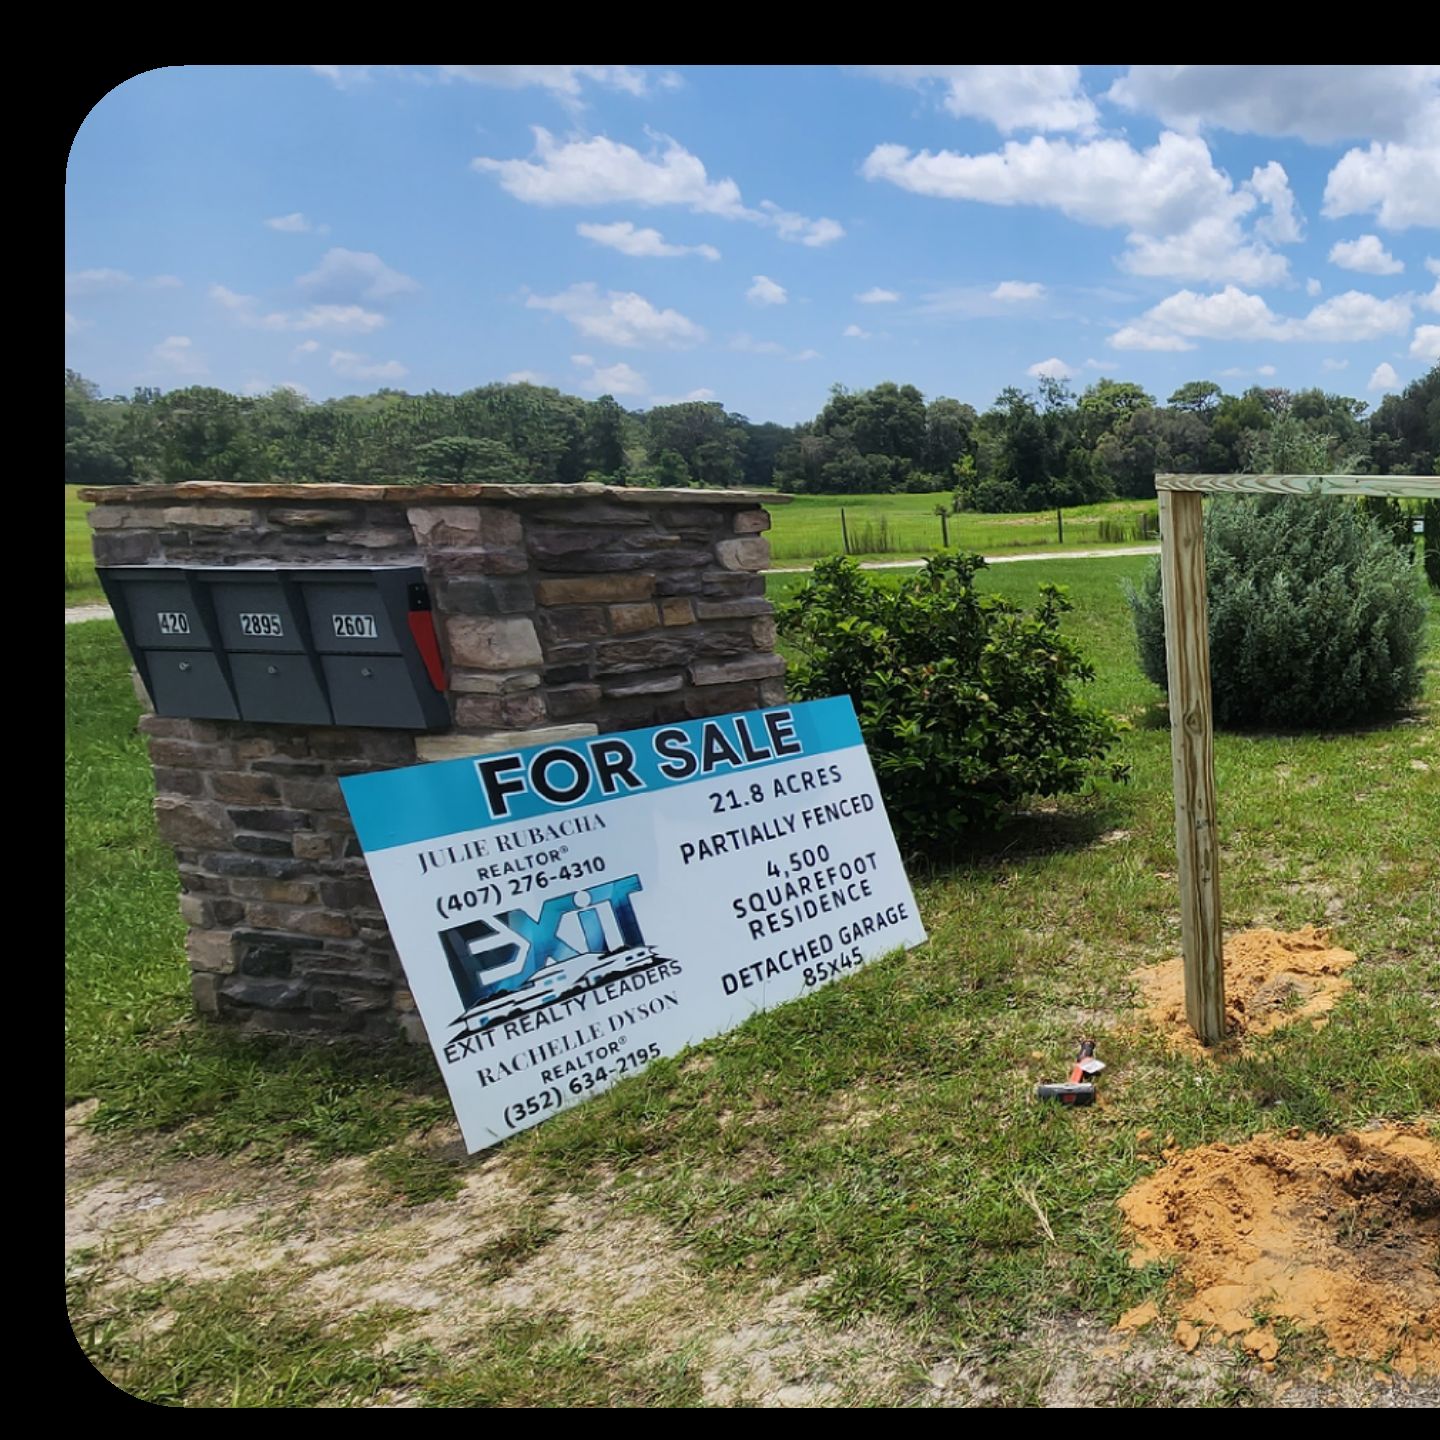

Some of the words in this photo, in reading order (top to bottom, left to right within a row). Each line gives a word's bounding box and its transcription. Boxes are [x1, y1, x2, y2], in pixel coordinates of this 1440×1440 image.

[160, 613, 189, 634] 420
[243, 614, 282, 636] 2895
[335, 616, 374, 637] 2607
[475, 739, 646, 819] FOR
[653, 709, 802, 781] SALE
[708, 783, 764, 813] 21.8
[773, 765, 842, 798] ACRES
[418, 839, 489, 874] JULIE
[496, 813, 606, 852] RUBACHA
[679, 814, 795, 864] PARTIALLY
[802, 793, 874, 829] FENCED
[436, 884, 502, 918] (407)
[509, 856, 606, 896] 276-4310
[733, 852, 878, 919] SQUAREFOOT
[767, 844, 830, 880] 4,500
[749, 879, 872, 940] RESIDENCE
[722, 933, 833, 996] DETACHED
[839, 902, 909, 945] GARAGE
[443, 1029, 497, 1065] EXIT
[504, 995, 587, 1041] REALTY
[593, 961, 683, 1006] LEADERS
[475, 1024, 605, 1088] RACHELLE
[608, 991, 680, 1033] DYSON
[503, 1087, 563, 1129] (352)
[569, 1042, 661, 1096] 634-2195
